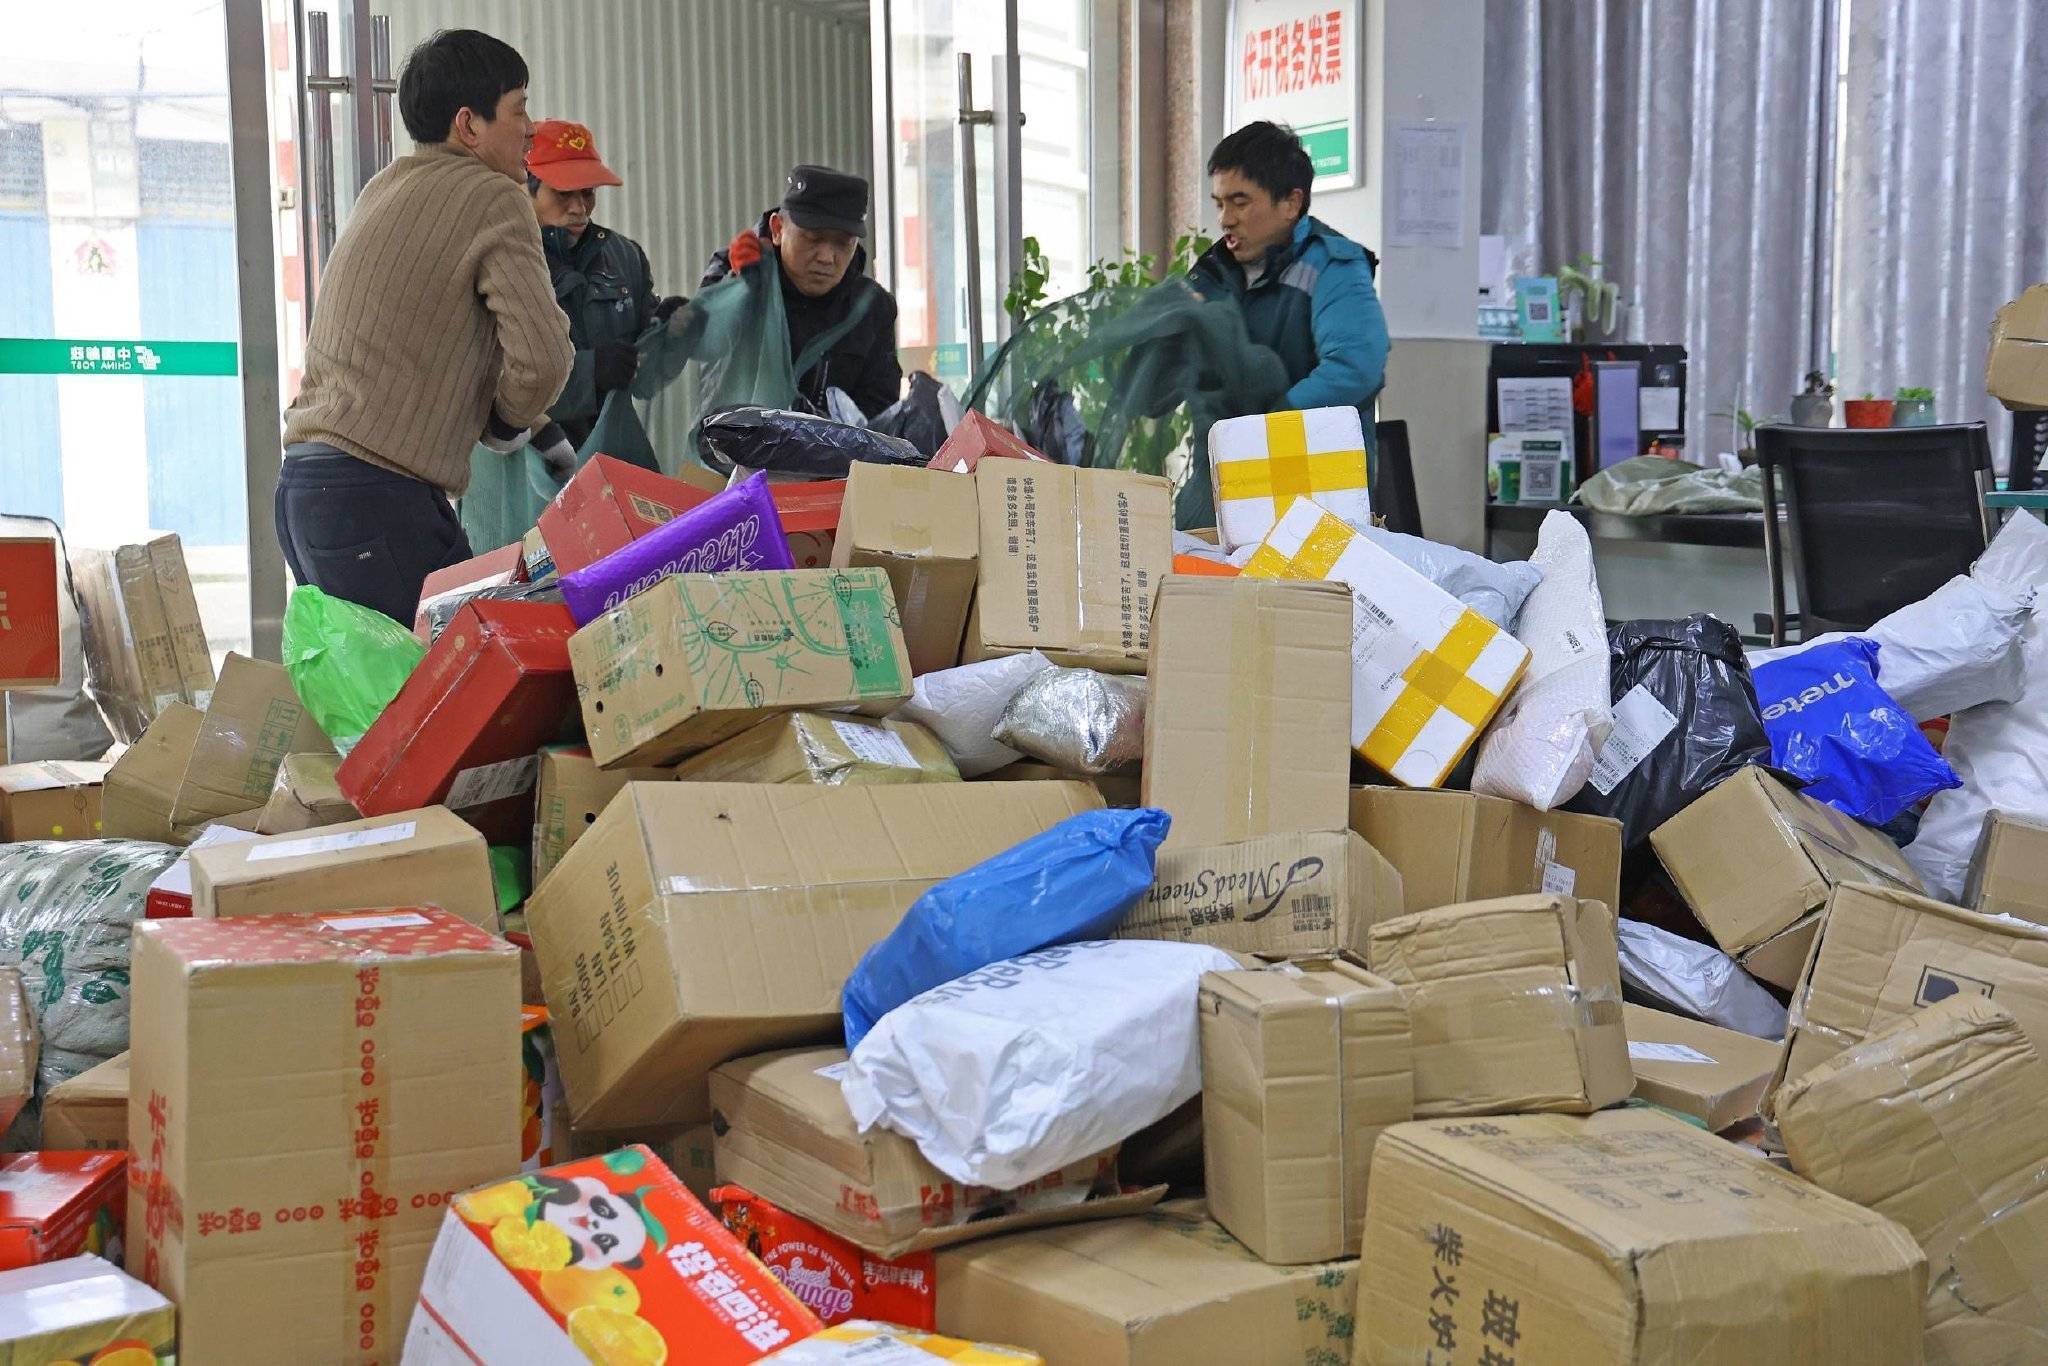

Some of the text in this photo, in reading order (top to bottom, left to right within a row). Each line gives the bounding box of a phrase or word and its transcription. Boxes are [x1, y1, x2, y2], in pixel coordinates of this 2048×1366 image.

[1245, 11, 1341, 102] 代开税务发票
[575, 952, 594, 1004] HONG
[591, 951, 608, 989] LAN
[778, 1241, 806, 1254] POWER
[808, 1244, 819, 1256] OF
